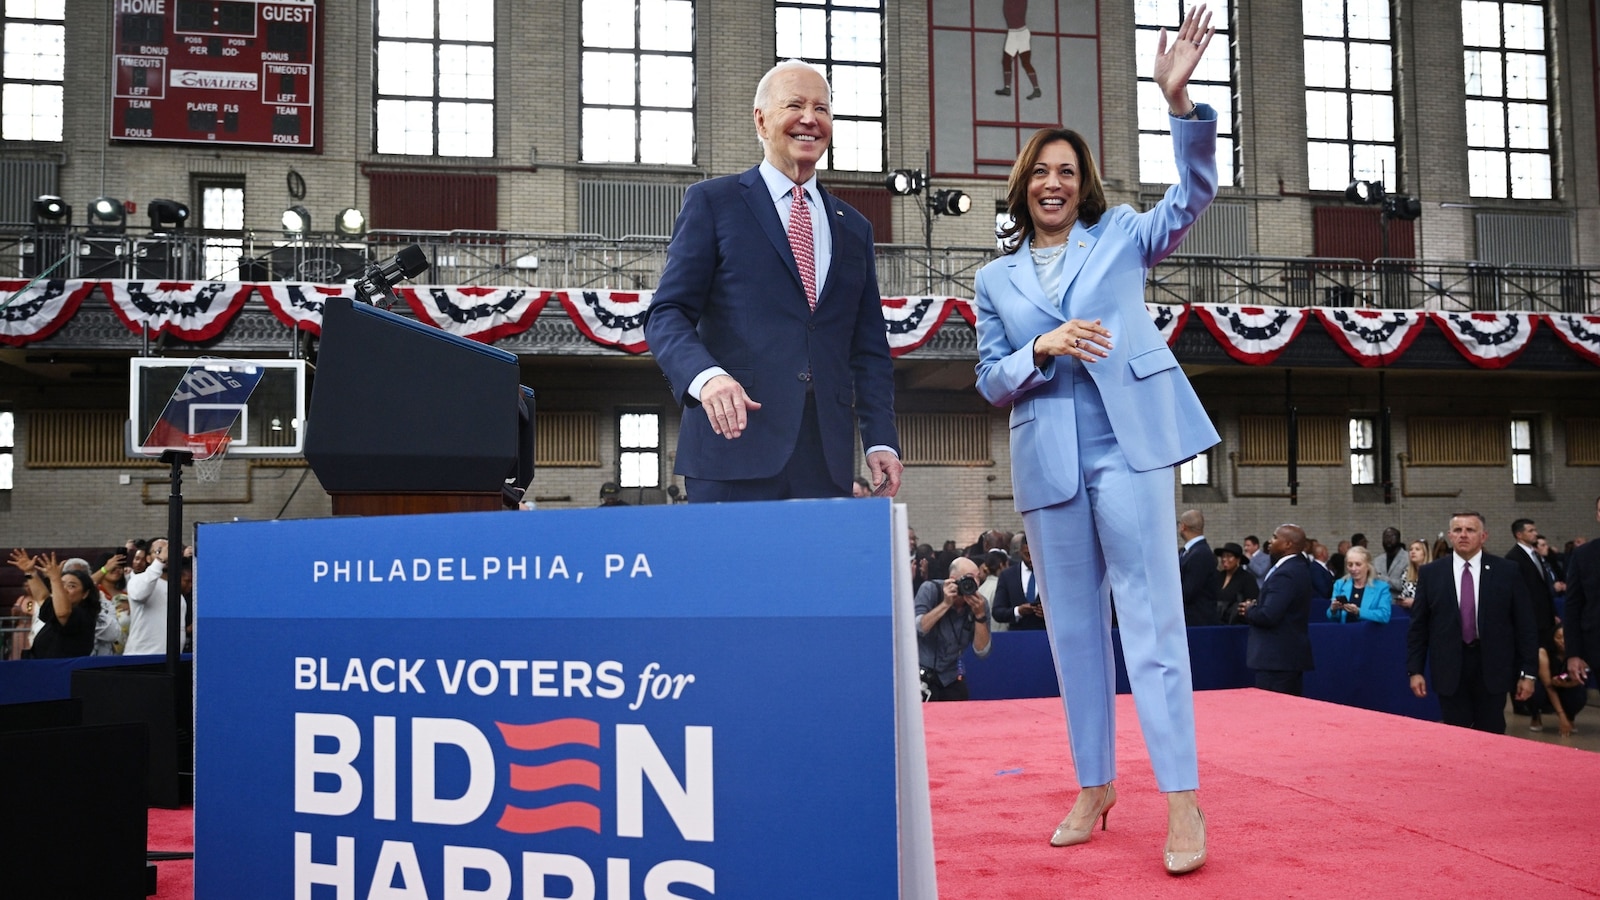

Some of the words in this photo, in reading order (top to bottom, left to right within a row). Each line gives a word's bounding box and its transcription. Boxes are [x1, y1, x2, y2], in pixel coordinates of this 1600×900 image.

[121, 0, 165, 14] HOME
[262, 6, 312, 22] GUEST
[184, 36, 203, 44] POSS
[228, 38, 246, 46] POSS
[140, 45, 169, 55] BONUS
[261, 52, 289, 61] BONUS
[120, 57, 161, 68] TIMEOUTS
[268, 64, 307, 75] TIMEOUTS
[129, 86, 149, 95] LEFT
[277, 93, 297, 102] LEFT
[128, 100, 151, 109] TEAM
[187, 102, 218, 112] PLAYER
[223, 103, 239, 113] FLS
[275, 106, 298, 116] TEAM
[125, 127, 152, 138] FOULS
[272, 134, 299, 144] FOULS
[312, 554, 584, 584] PHILADELPHIA,
[605, 553, 654, 579] PA
[294, 656, 426, 694] BLACK
[436, 658, 625, 699] VOTERS
[629, 661, 695, 710] for
[294, 711, 714, 843] BIDEN
